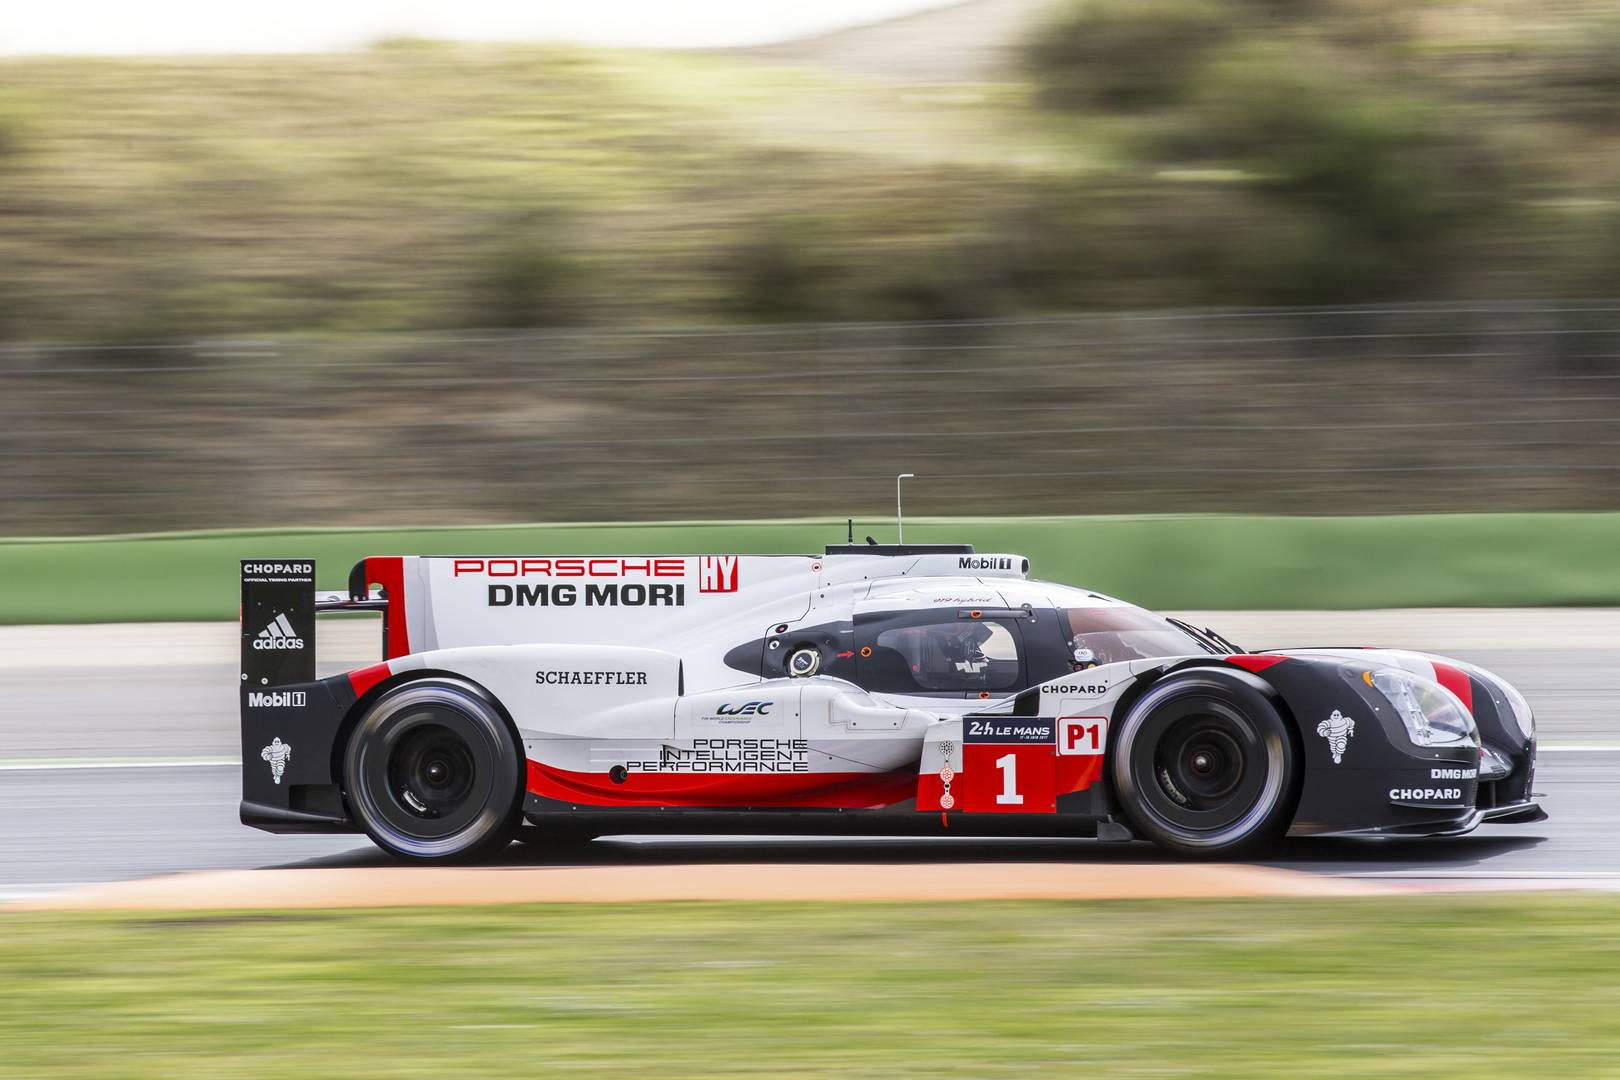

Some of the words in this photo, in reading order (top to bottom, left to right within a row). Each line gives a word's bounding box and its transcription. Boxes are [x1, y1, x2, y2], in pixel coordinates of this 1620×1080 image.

[243, 564, 313, 574] CHOPARD
[454, 559, 685, 577] PORSCHE
[958, 557, 997, 570] Mobil
[999, 557, 1012, 570] 1
[699, 555, 738, 593] HY
[488, 584, 577, 607] DMG
[585, 584, 685, 606] MORI
[253, 636, 304, 649] adidas
[535, 670, 648, 685] SCHAEFFLER
[1041, 685, 1107, 694] CHOPARD
[248, 692, 290, 707] Mobil
[292, 691, 306, 707] 1
[716, 701, 773, 715] WEC
[996, 727, 1012, 735] LE
[1013, 727, 1050, 735] MANS
[1067, 724, 1099, 749] P1
[693, 739, 808, 749] PORSCHE
[659, 750, 808, 761] INTELLIGENT
[626, 761, 809, 772] PERFORMANCE
[995, 753, 1024, 805] 1
[1431, 769, 1461, 779] DMG
[1389, 788, 1461, 800] CHOPARD
